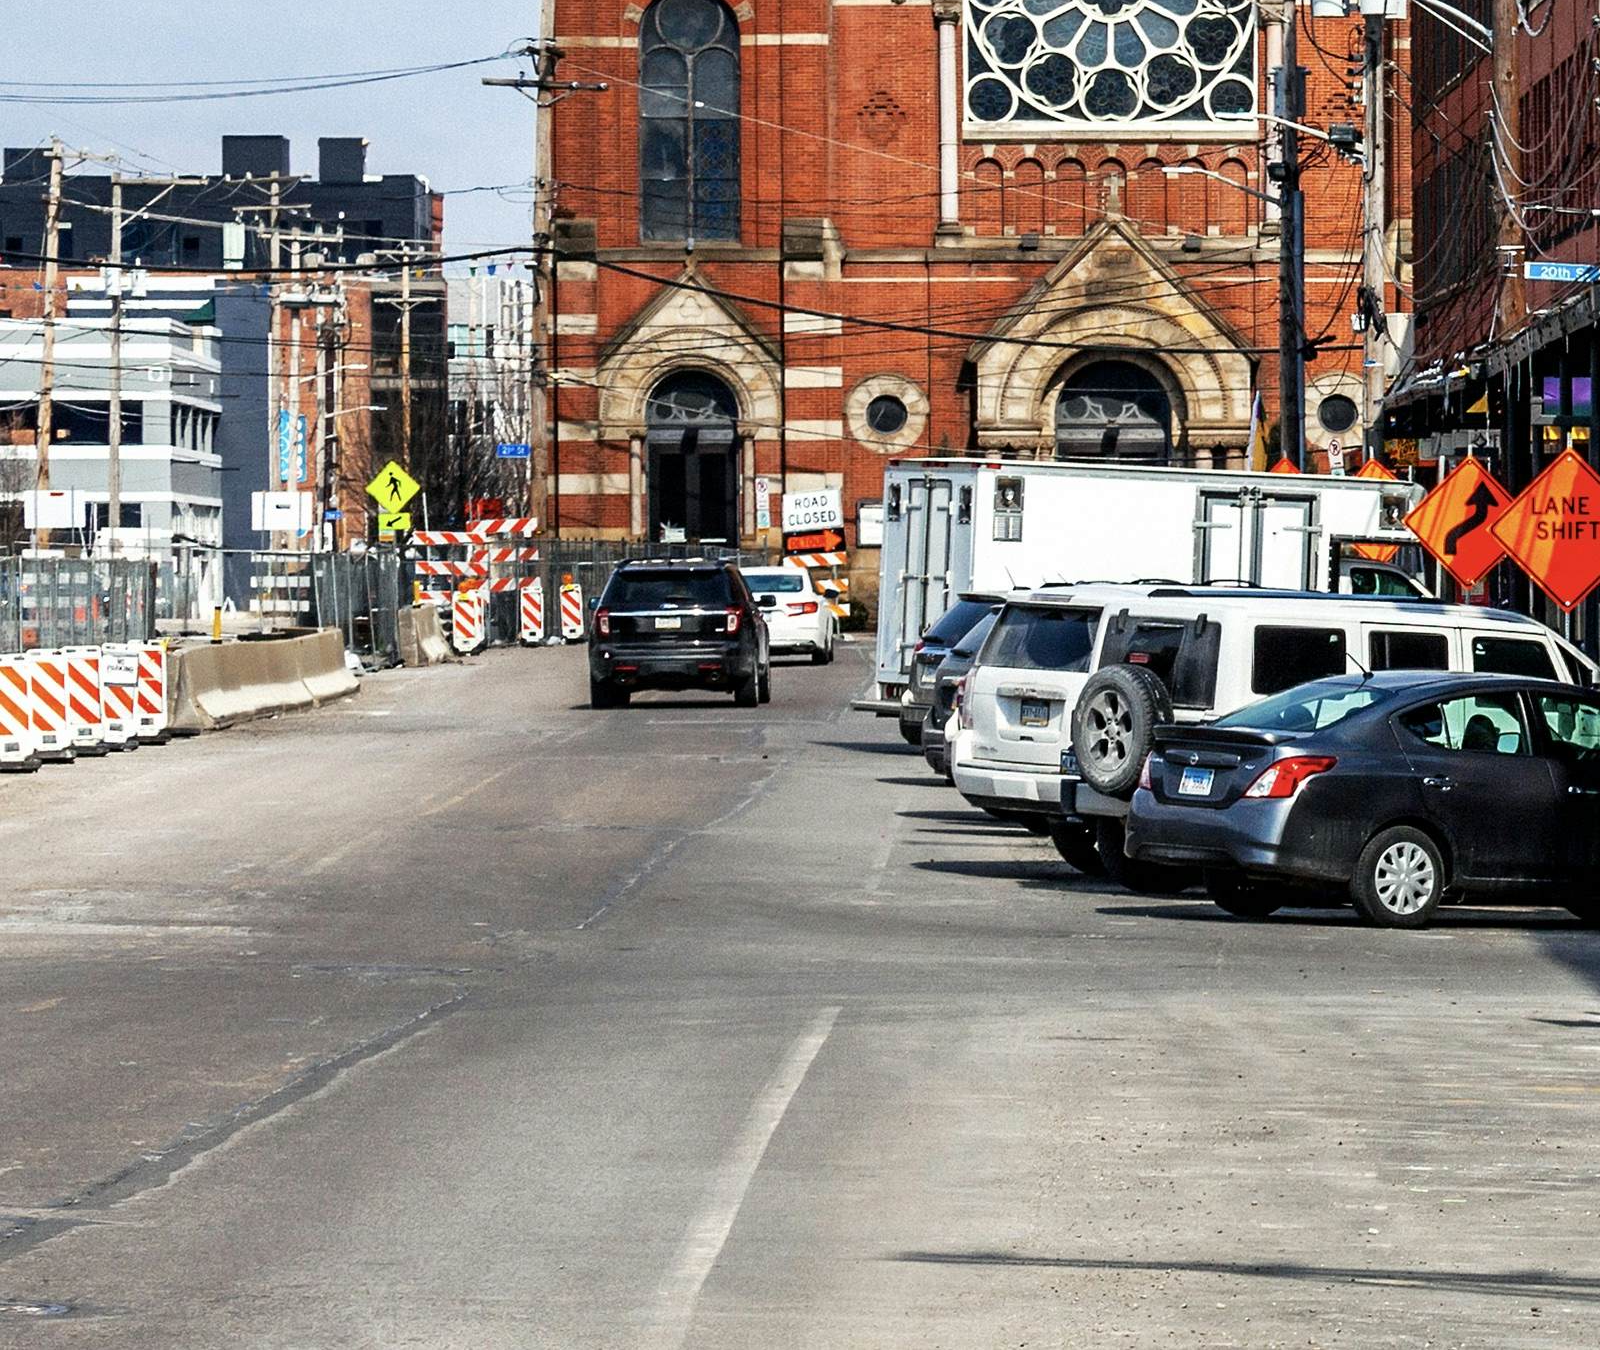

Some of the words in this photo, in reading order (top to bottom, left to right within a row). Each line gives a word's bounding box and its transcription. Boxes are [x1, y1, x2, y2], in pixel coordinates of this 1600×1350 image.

[1540, 266, 1571, 279] 20th
[794, 495, 828, 509] ROAD
[1531, 496, 1590, 516] LANE
[788, 510, 837, 526] CLOSED
[1537, 521, 1600, 540] SHIFT
